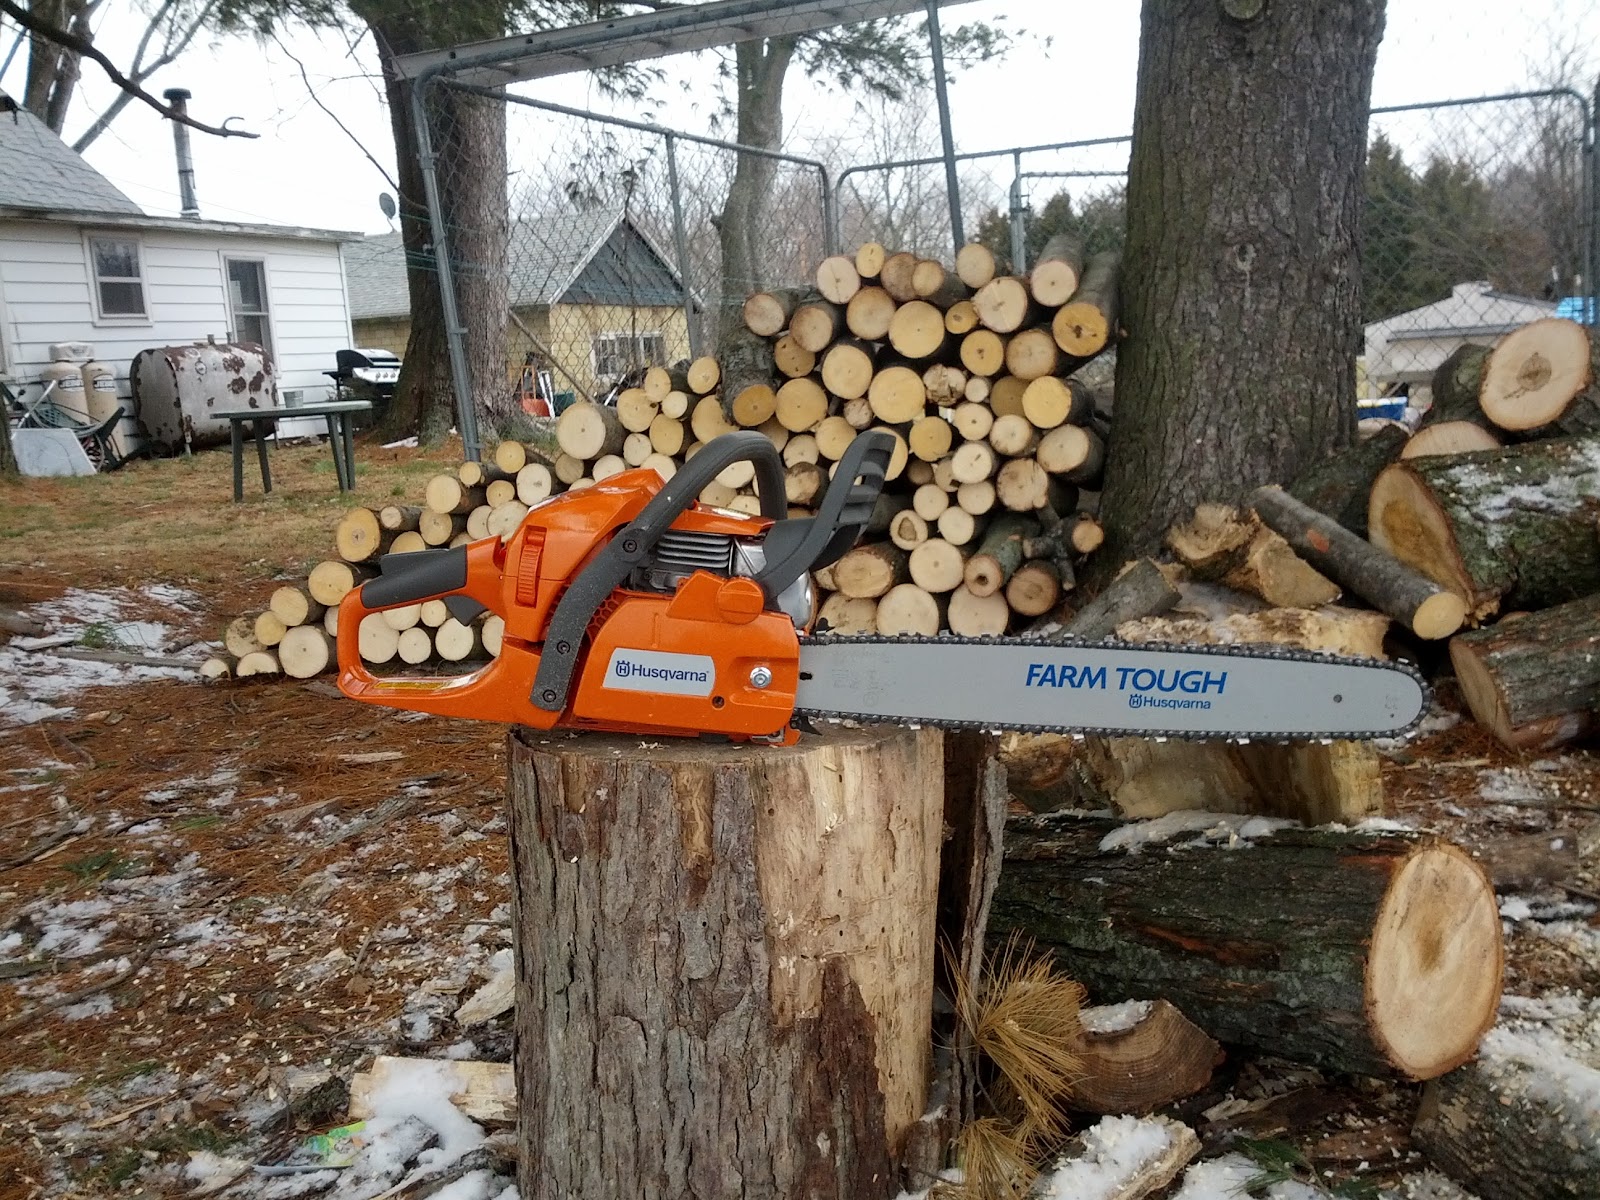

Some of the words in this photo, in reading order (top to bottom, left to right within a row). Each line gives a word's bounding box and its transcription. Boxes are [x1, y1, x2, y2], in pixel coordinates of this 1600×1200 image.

[631, 663, 707, 682] Husqvarna
[1025, 663, 1107, 690] FARM
[1116, 667, 1228, 694] TOUGH
[1143, 696, 1211, 710] Husqvarna
